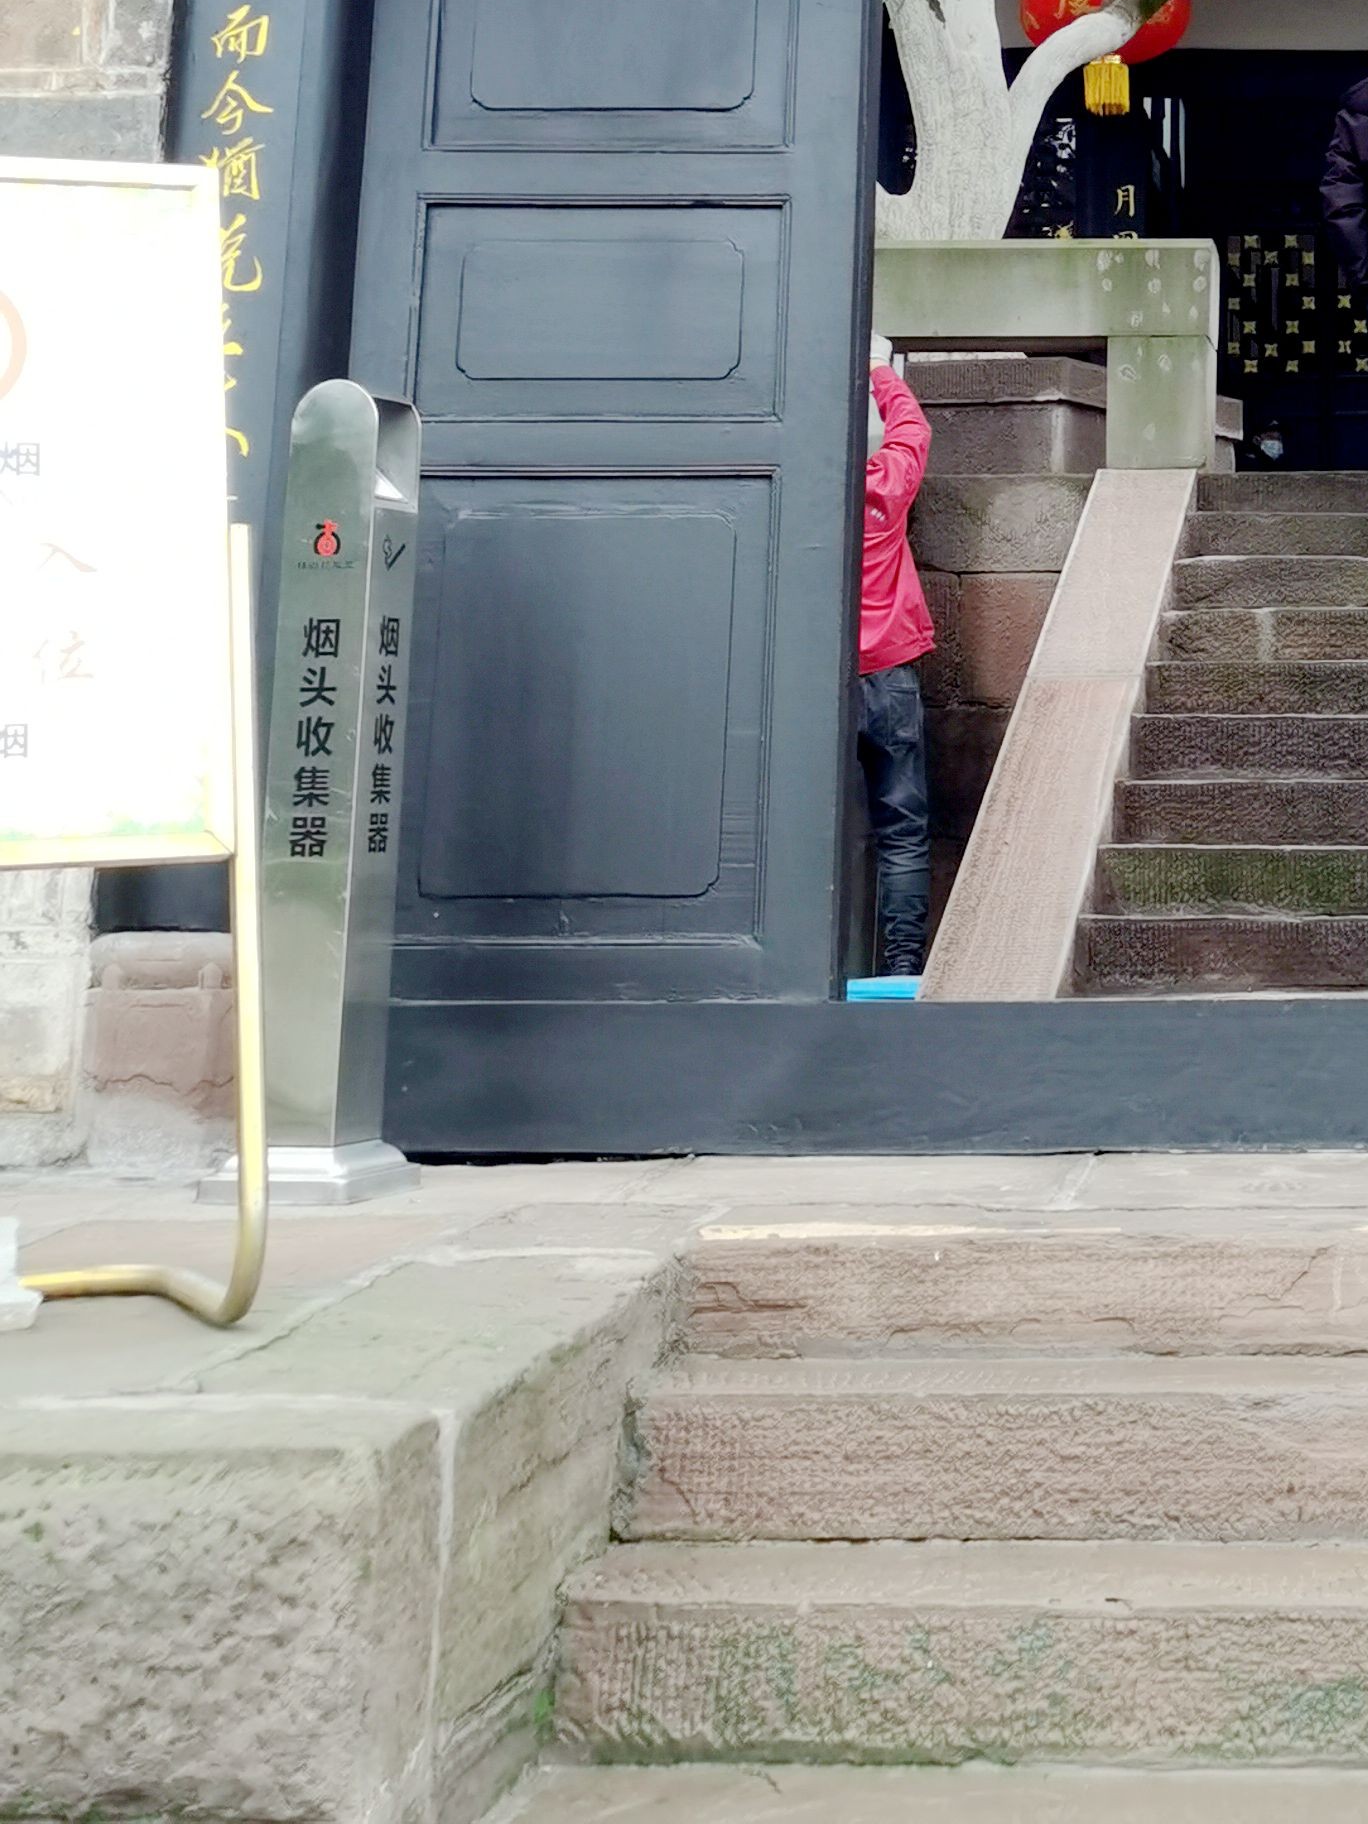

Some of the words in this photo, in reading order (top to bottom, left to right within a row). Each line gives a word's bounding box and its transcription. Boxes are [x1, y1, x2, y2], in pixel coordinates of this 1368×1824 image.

[289, 617, 341, 858] 烟头收集器
[367, 615, 400, 854] 烟头收集器
